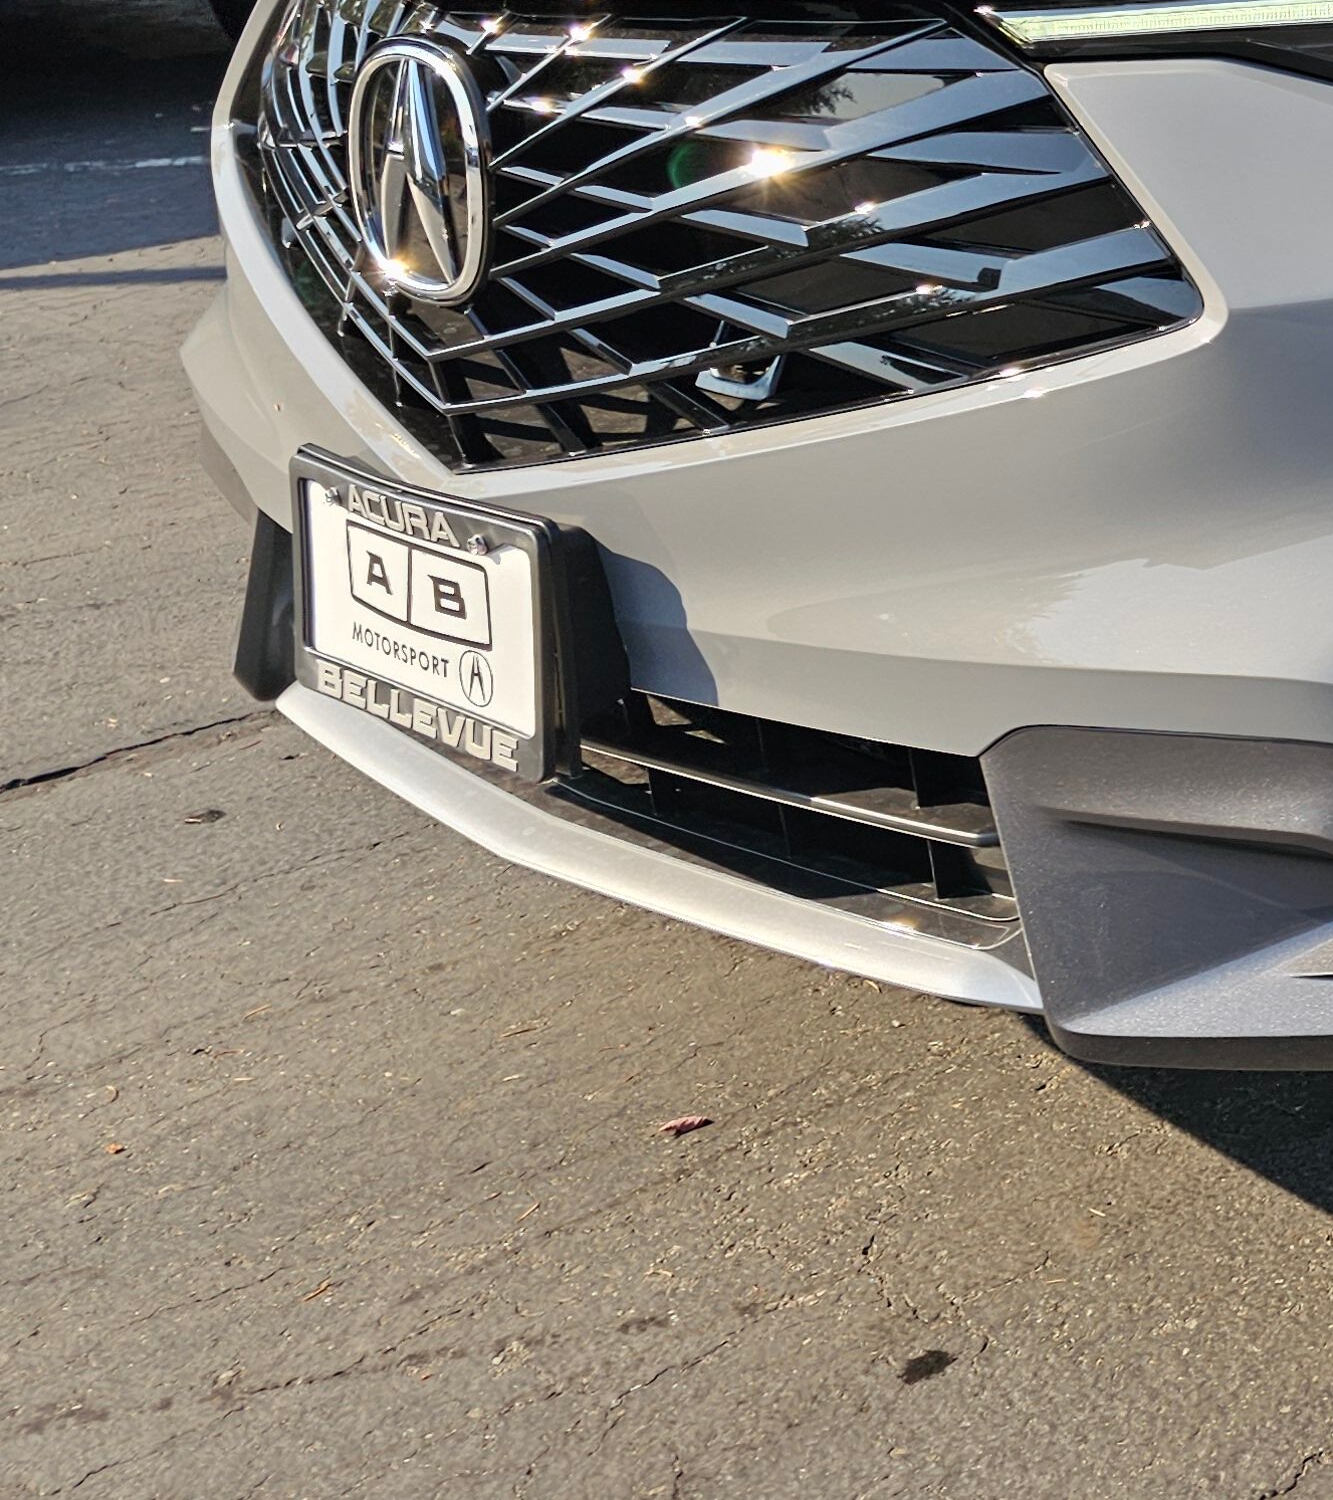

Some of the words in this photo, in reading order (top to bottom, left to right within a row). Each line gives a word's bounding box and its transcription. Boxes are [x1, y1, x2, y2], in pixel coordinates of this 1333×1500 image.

[348, 484, 461, 548] ACURA
[366, 550, 394, 596] A
[427, 574, 467, 621] B
[352, 621, 450, 678] MOTORSPORT
[315, 658, 519, 773] BELLEVUE
